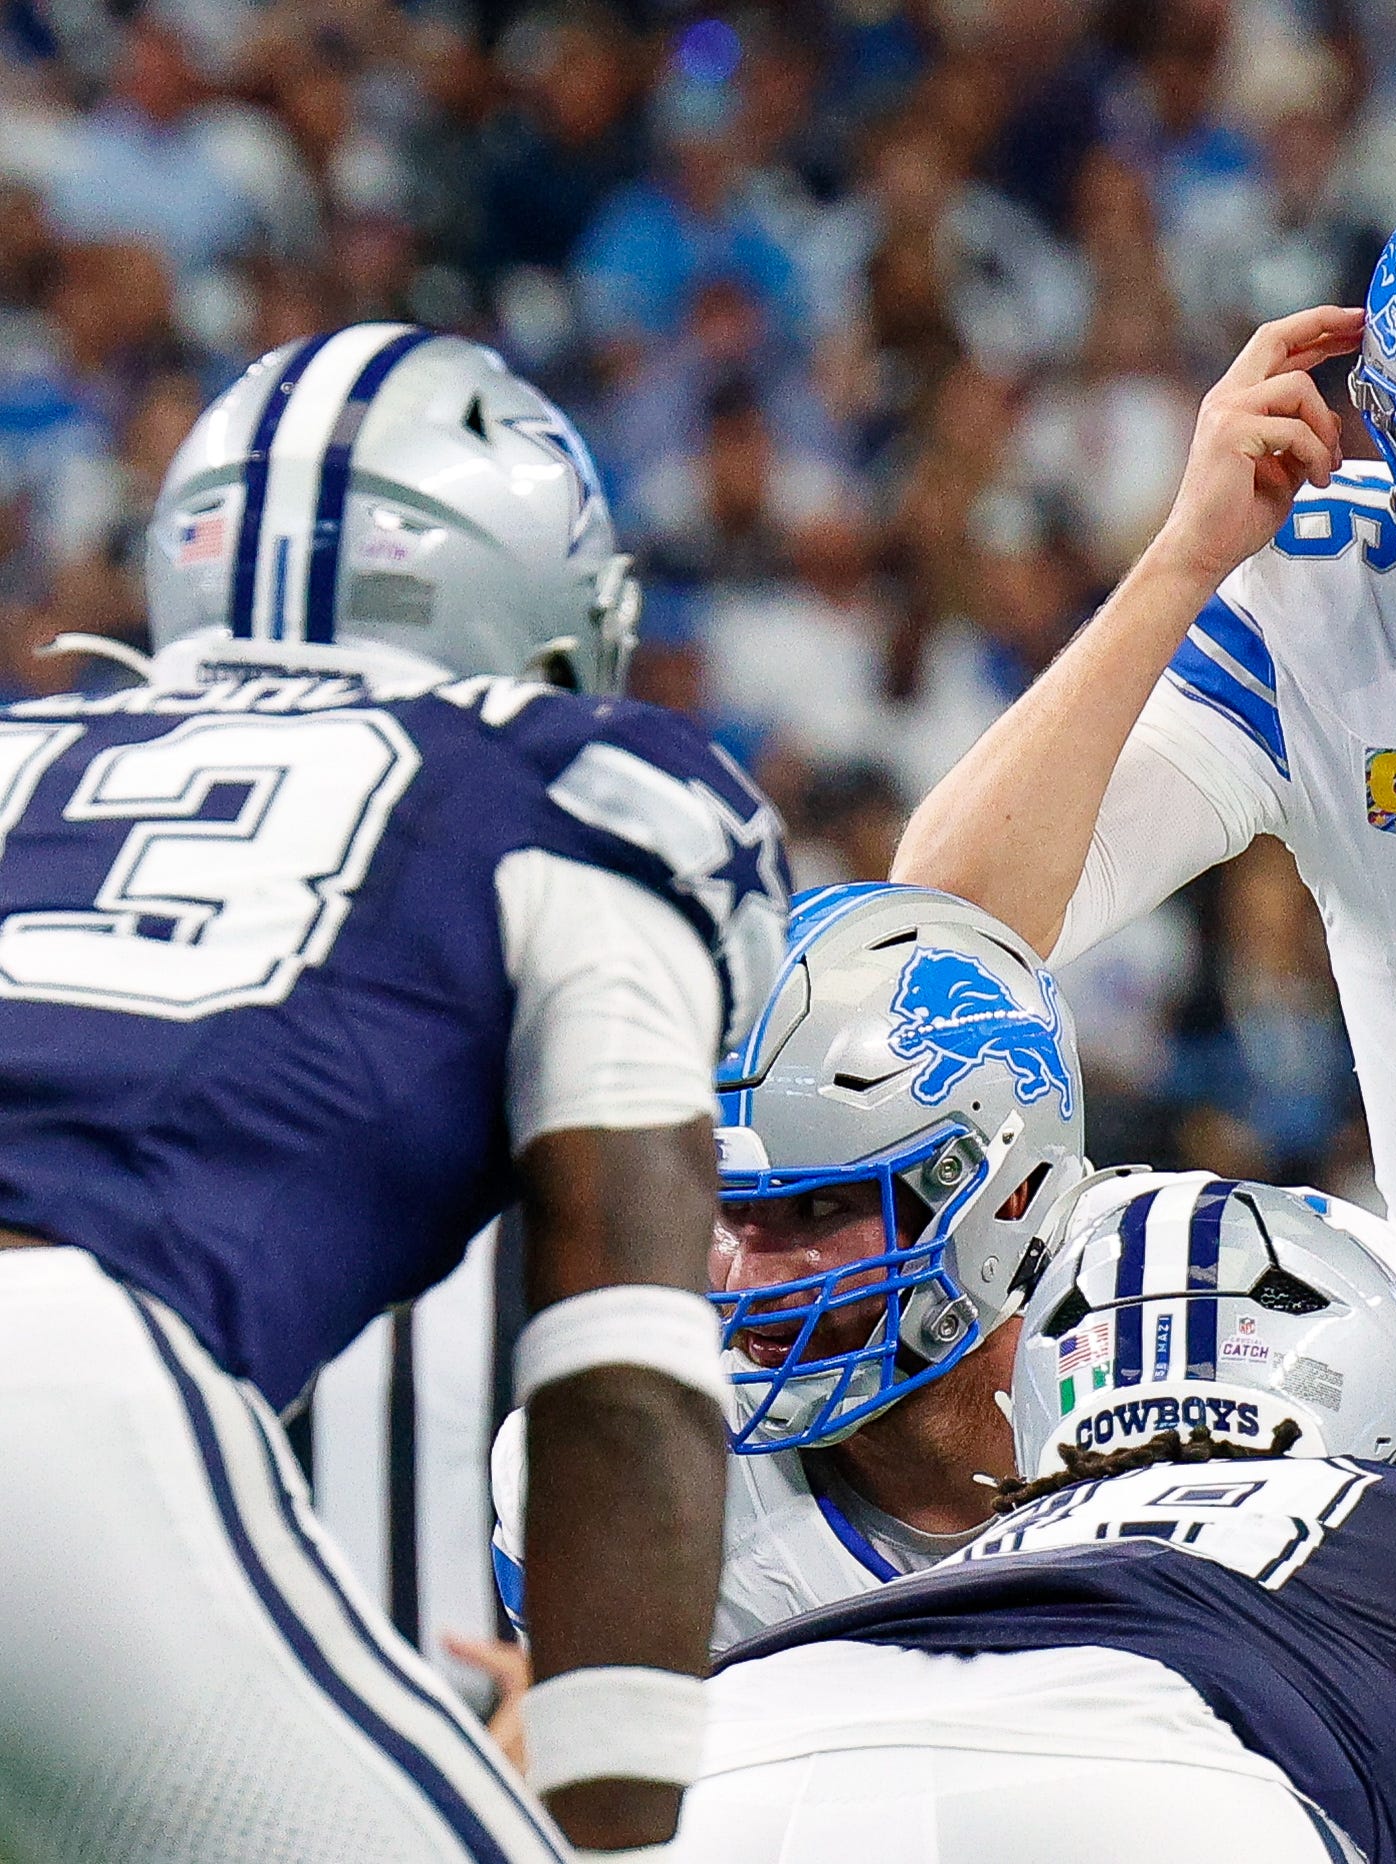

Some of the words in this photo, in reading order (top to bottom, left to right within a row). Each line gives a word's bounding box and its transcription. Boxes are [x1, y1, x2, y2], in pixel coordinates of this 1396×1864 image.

[1157, 1317, 1170, 1353] MAZI
[1223, 1343, 1270, 1359] CATCH
[1076, 1396, 1260, 1451] COWBOYS
